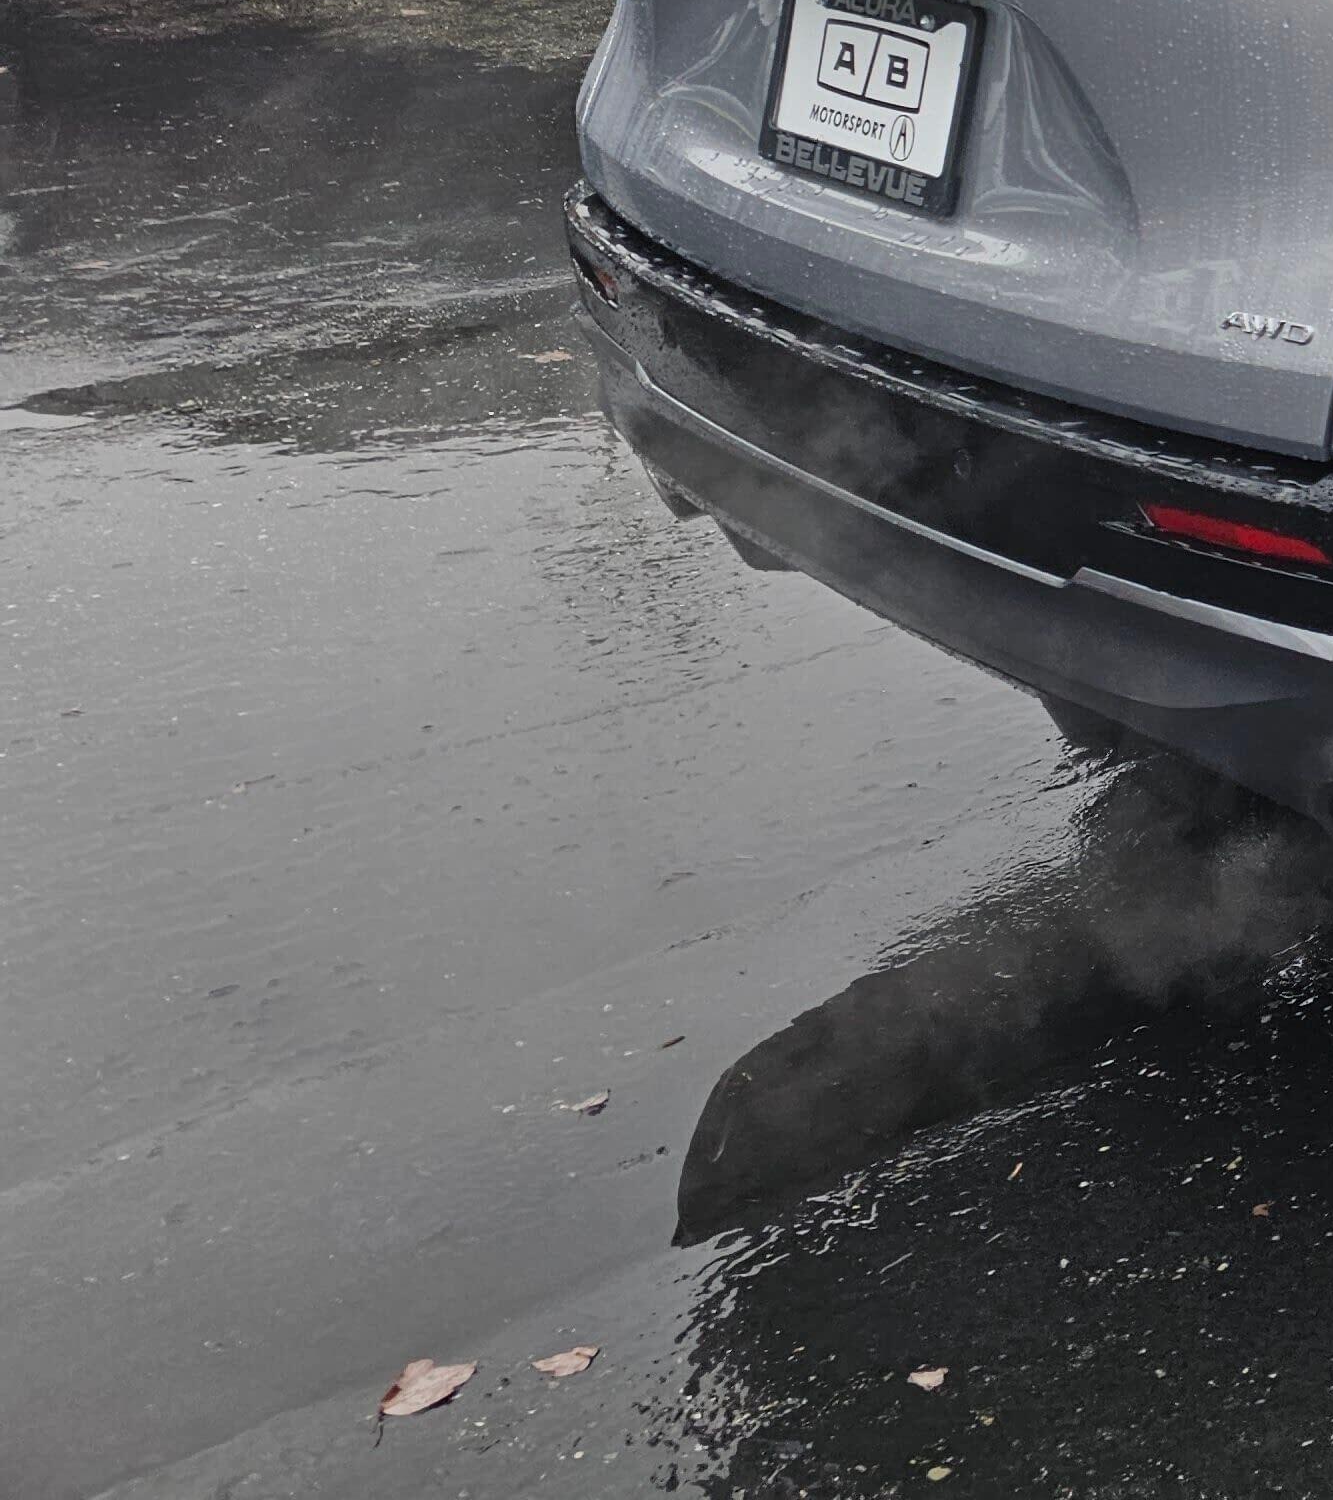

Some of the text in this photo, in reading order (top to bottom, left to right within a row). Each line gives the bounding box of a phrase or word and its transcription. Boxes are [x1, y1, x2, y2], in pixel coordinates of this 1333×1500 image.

[833, 41, 909, 90] A B
[809, 103, 886, 141] MOTORSPORT
[775, 133, 928, 207] BELLEVUE
[1219, 311, 1315, 346] AWD
